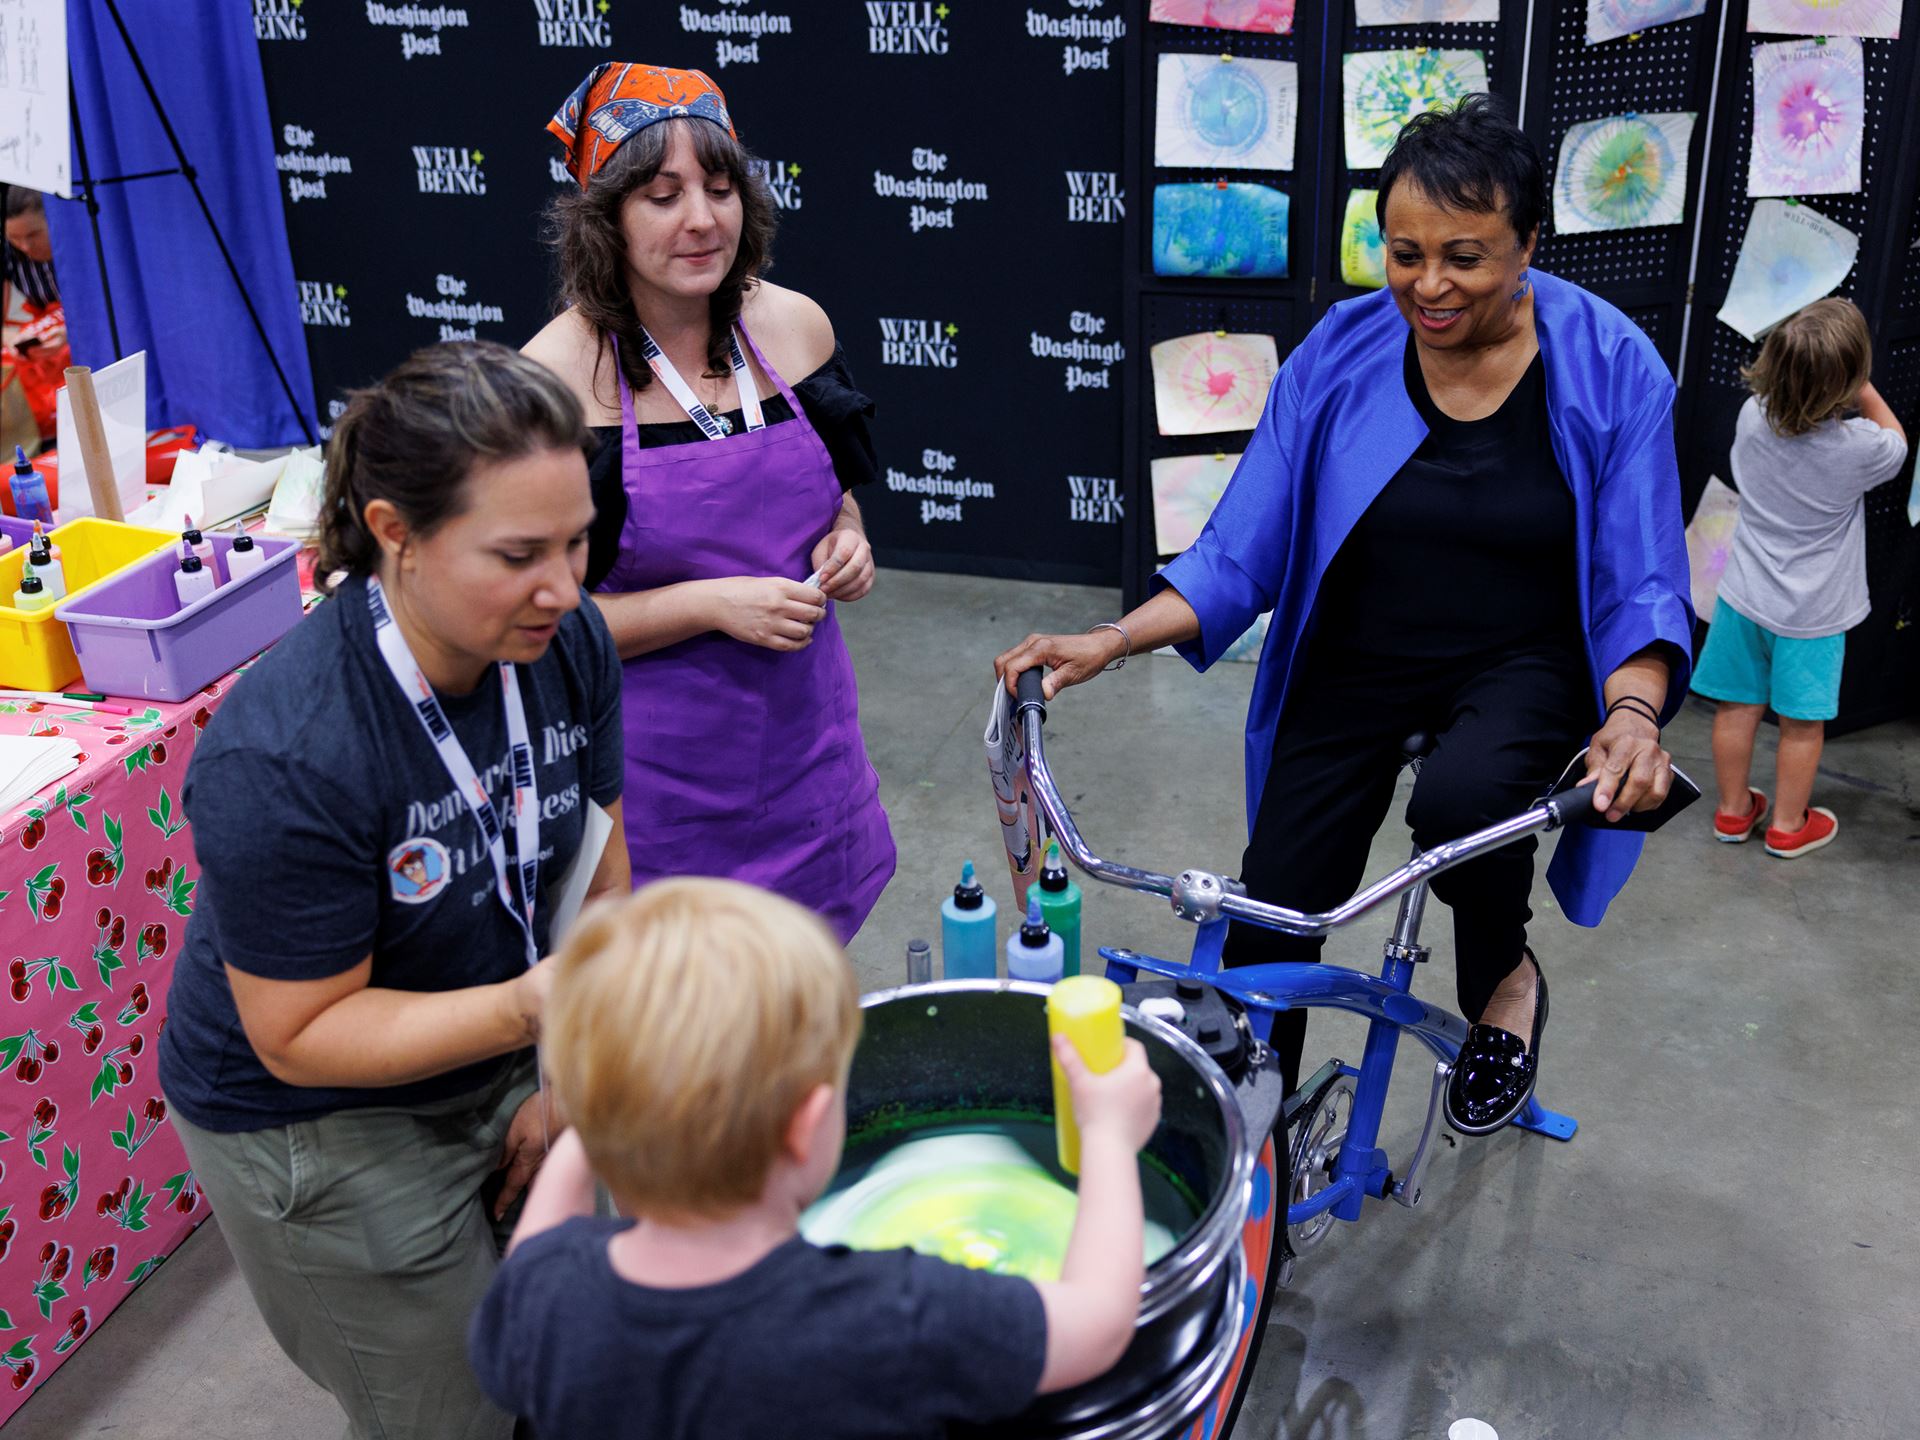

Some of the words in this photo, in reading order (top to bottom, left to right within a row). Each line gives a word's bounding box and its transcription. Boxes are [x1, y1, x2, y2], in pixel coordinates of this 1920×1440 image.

[254, 16, 307, 40] EING
[366, 0, 469, 31] Washington
[679, 4, 792, 39] Washington
[1025, 8, 1126, 44] Washingt
[401, 32, 441, 60] Post
[538, 21, 612, 48] BEING
[869, 27, 949, 55] BEING
[716, 40, 760, 69] Post
[1063, 46, 1110, 76] Post
[284, 124, 315, 149] The
[275, 150, 353, 178] ashington
[912, 147, 948, 174] The
[288, 176, 328, 203] Post
[417, 169, 487, 195] BEING
[873, 170, 988, 205] Washington
[1065, 171, 1125, 198] WEL
[910, 205, 955, 233] Post
[1068, 196, 1126, 223] BEIN
[436, 273, 467, 299] The
[300, 302, 351, 327] EING
[406, 292, 504, 326] Washington
[1069, 310, 1106, 337] The
[882, 341, 958, 369] BEING
[1030, 331, 1125, 366] Washingt
[1065, 365, 1109, 392] Post
[688, 404, 721, 438] LIBRARY
[922, 448, 957, 473] The
[886, 467, 995, 500] Washington
[1067, 476, 1124, 501] WEL
[921, 499, 962, 525] Post
[1070, 498, 1124, 523] BEIN
[541, 720, 589, 766] Dies
